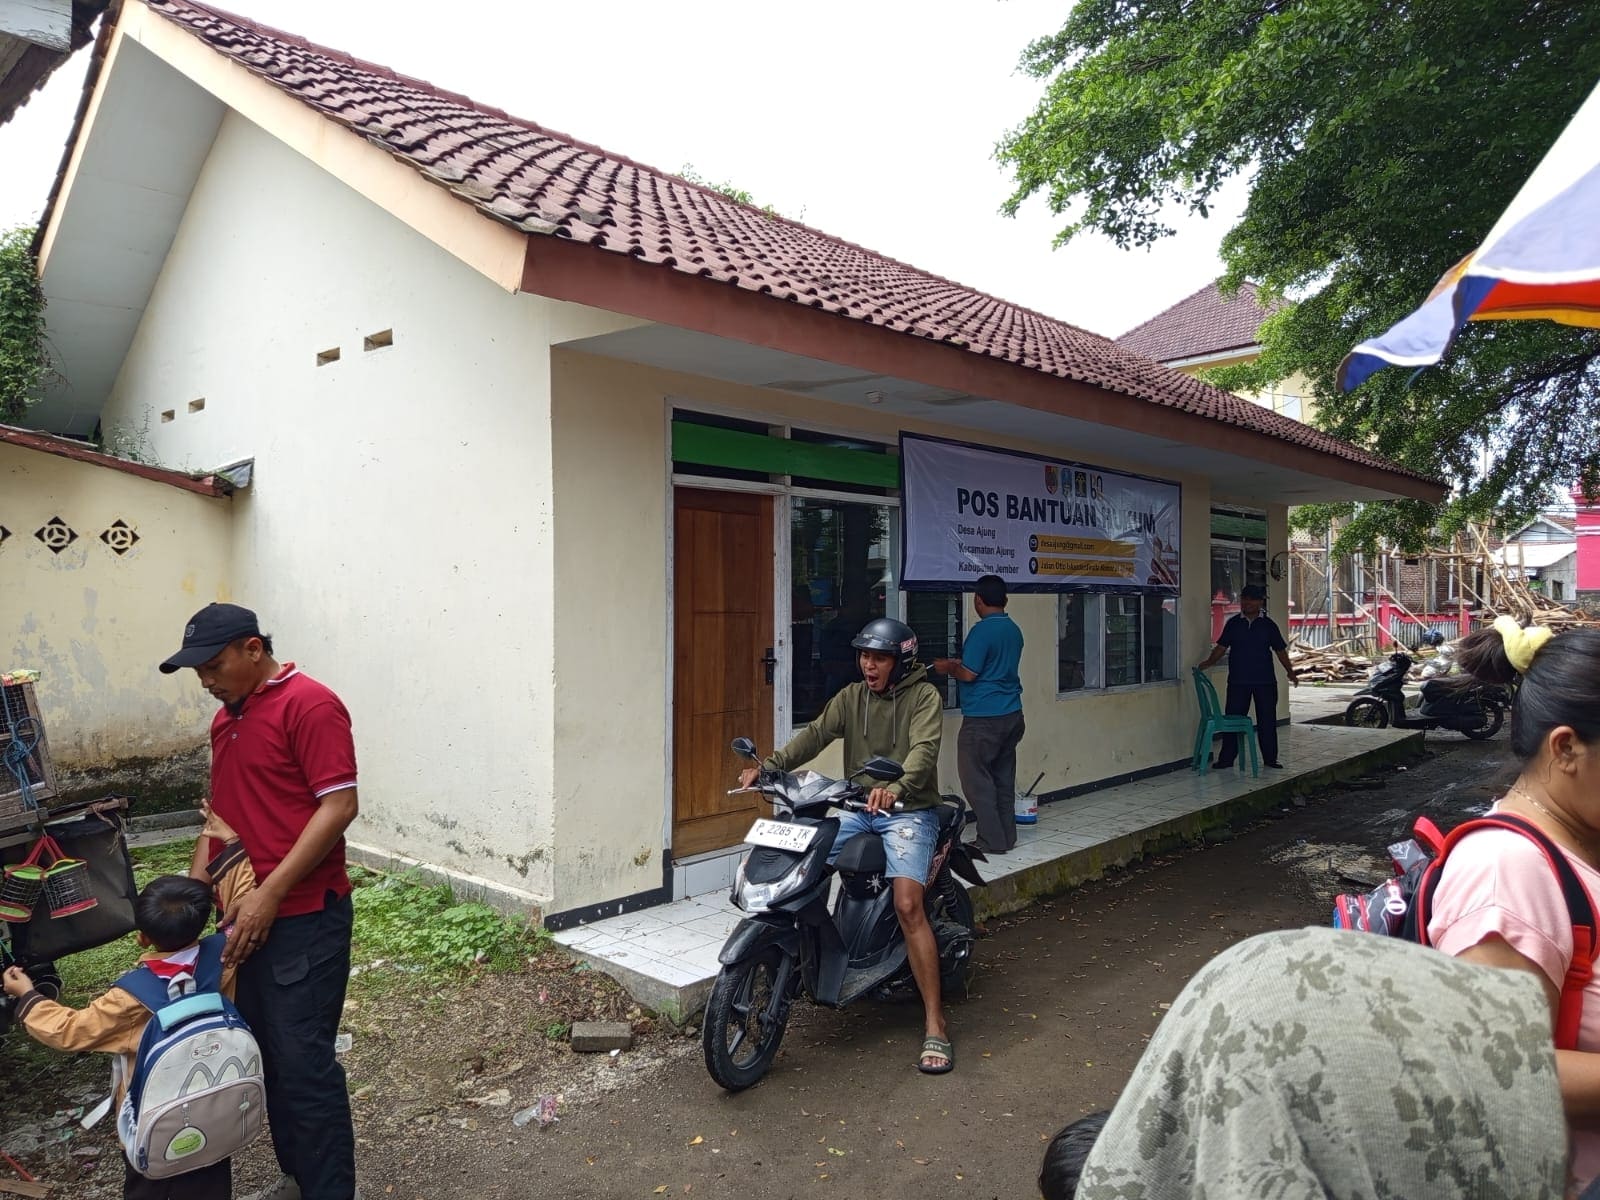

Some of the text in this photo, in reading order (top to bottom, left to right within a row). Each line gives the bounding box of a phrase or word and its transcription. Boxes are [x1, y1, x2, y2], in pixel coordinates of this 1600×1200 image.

[957, 487, 999, 517] POS
[1006, 494, 1097, 528] BANTUAN
[957, 524, 996, 539] Desa Ajung
[996, 546, 1015, 558] Ajung
[767, 824, 794, 836] 2285
